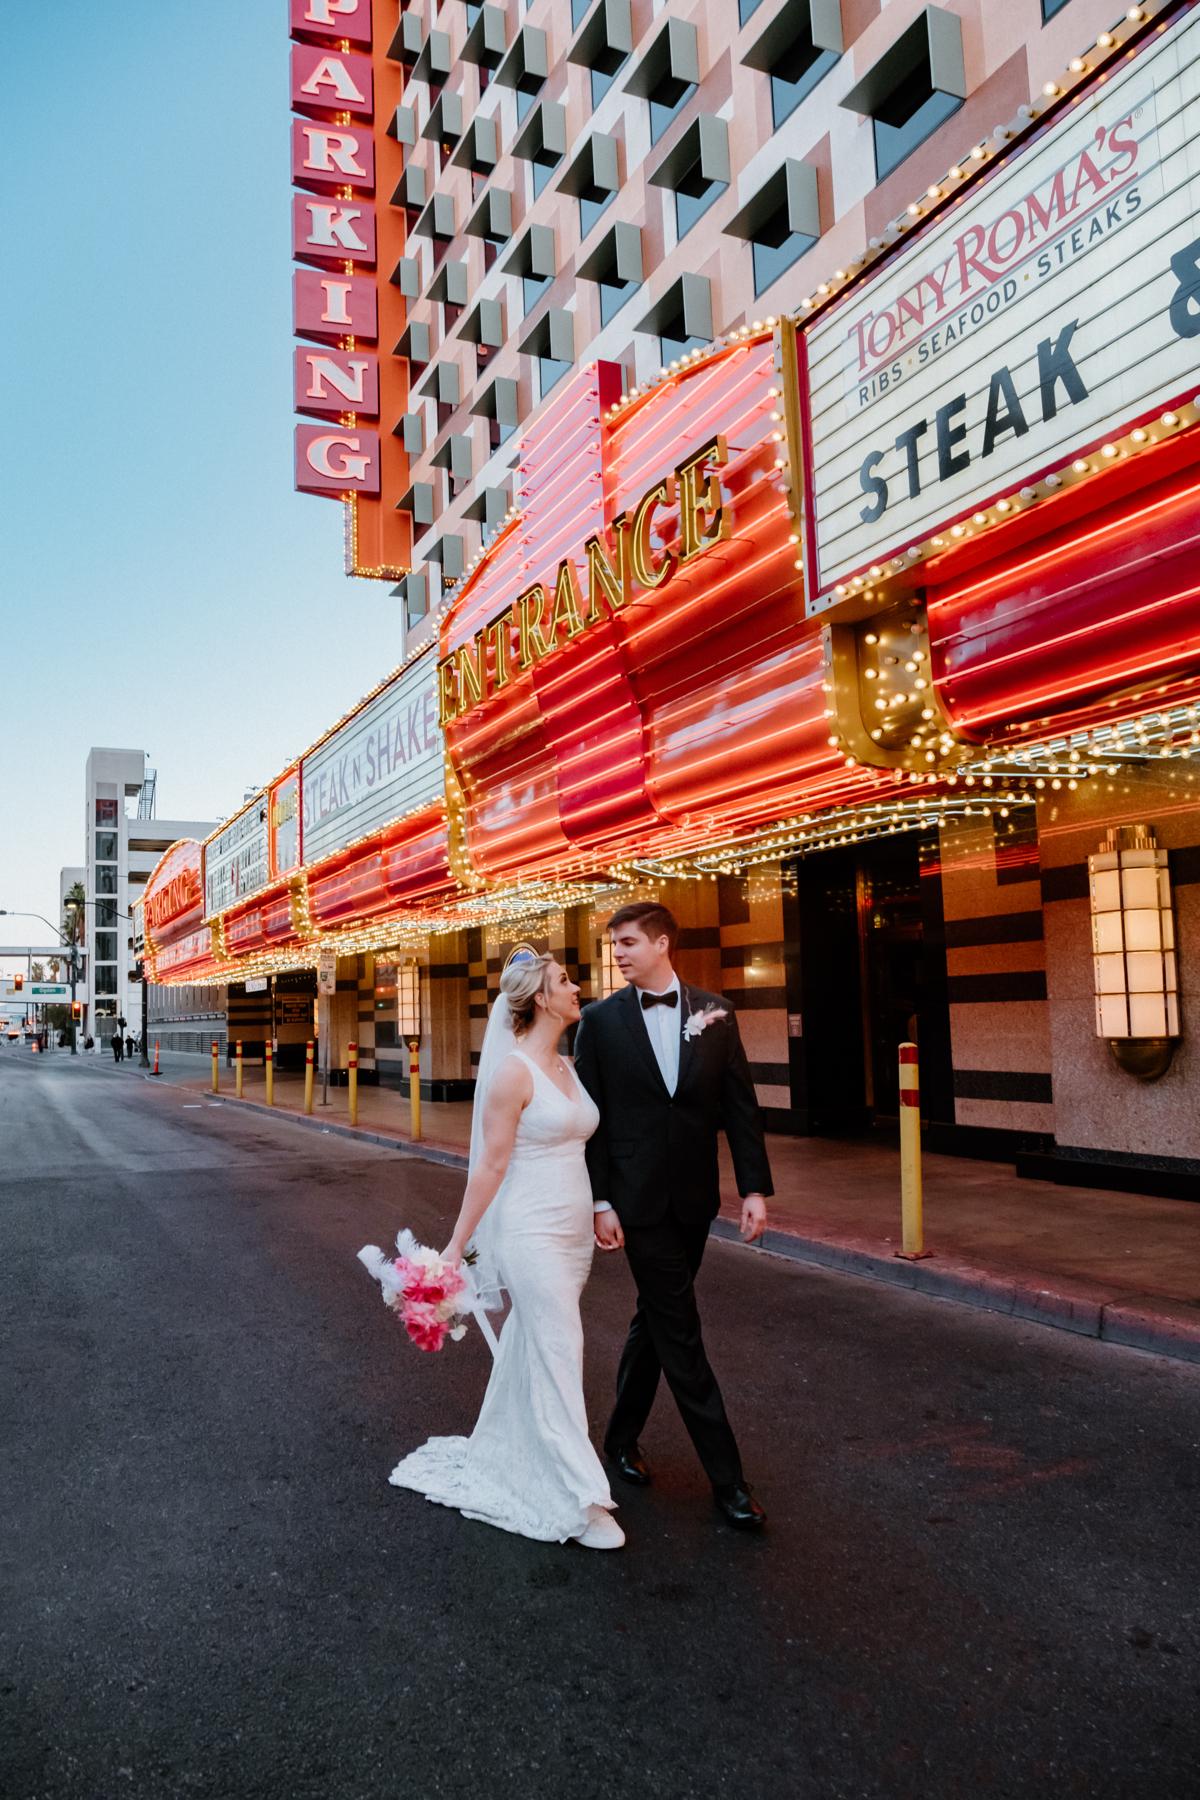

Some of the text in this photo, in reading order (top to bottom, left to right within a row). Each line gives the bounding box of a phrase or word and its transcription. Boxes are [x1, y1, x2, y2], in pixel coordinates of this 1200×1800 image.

[300, 0, 371, 481] PARKING
[847, 115, 1139, 373] TONY ROMA'S
[859, 187, 1142, 407] RIBS SEAFOOD STEAKS
[859, 318, 1089, 524] STEAK
[437, 434, 732, 729] ENTRANCE
[303, 754, 350, 829] STEAK
[366, 688, 437, 788] SHAKE
[144, 868, 193, 930] PARKING
